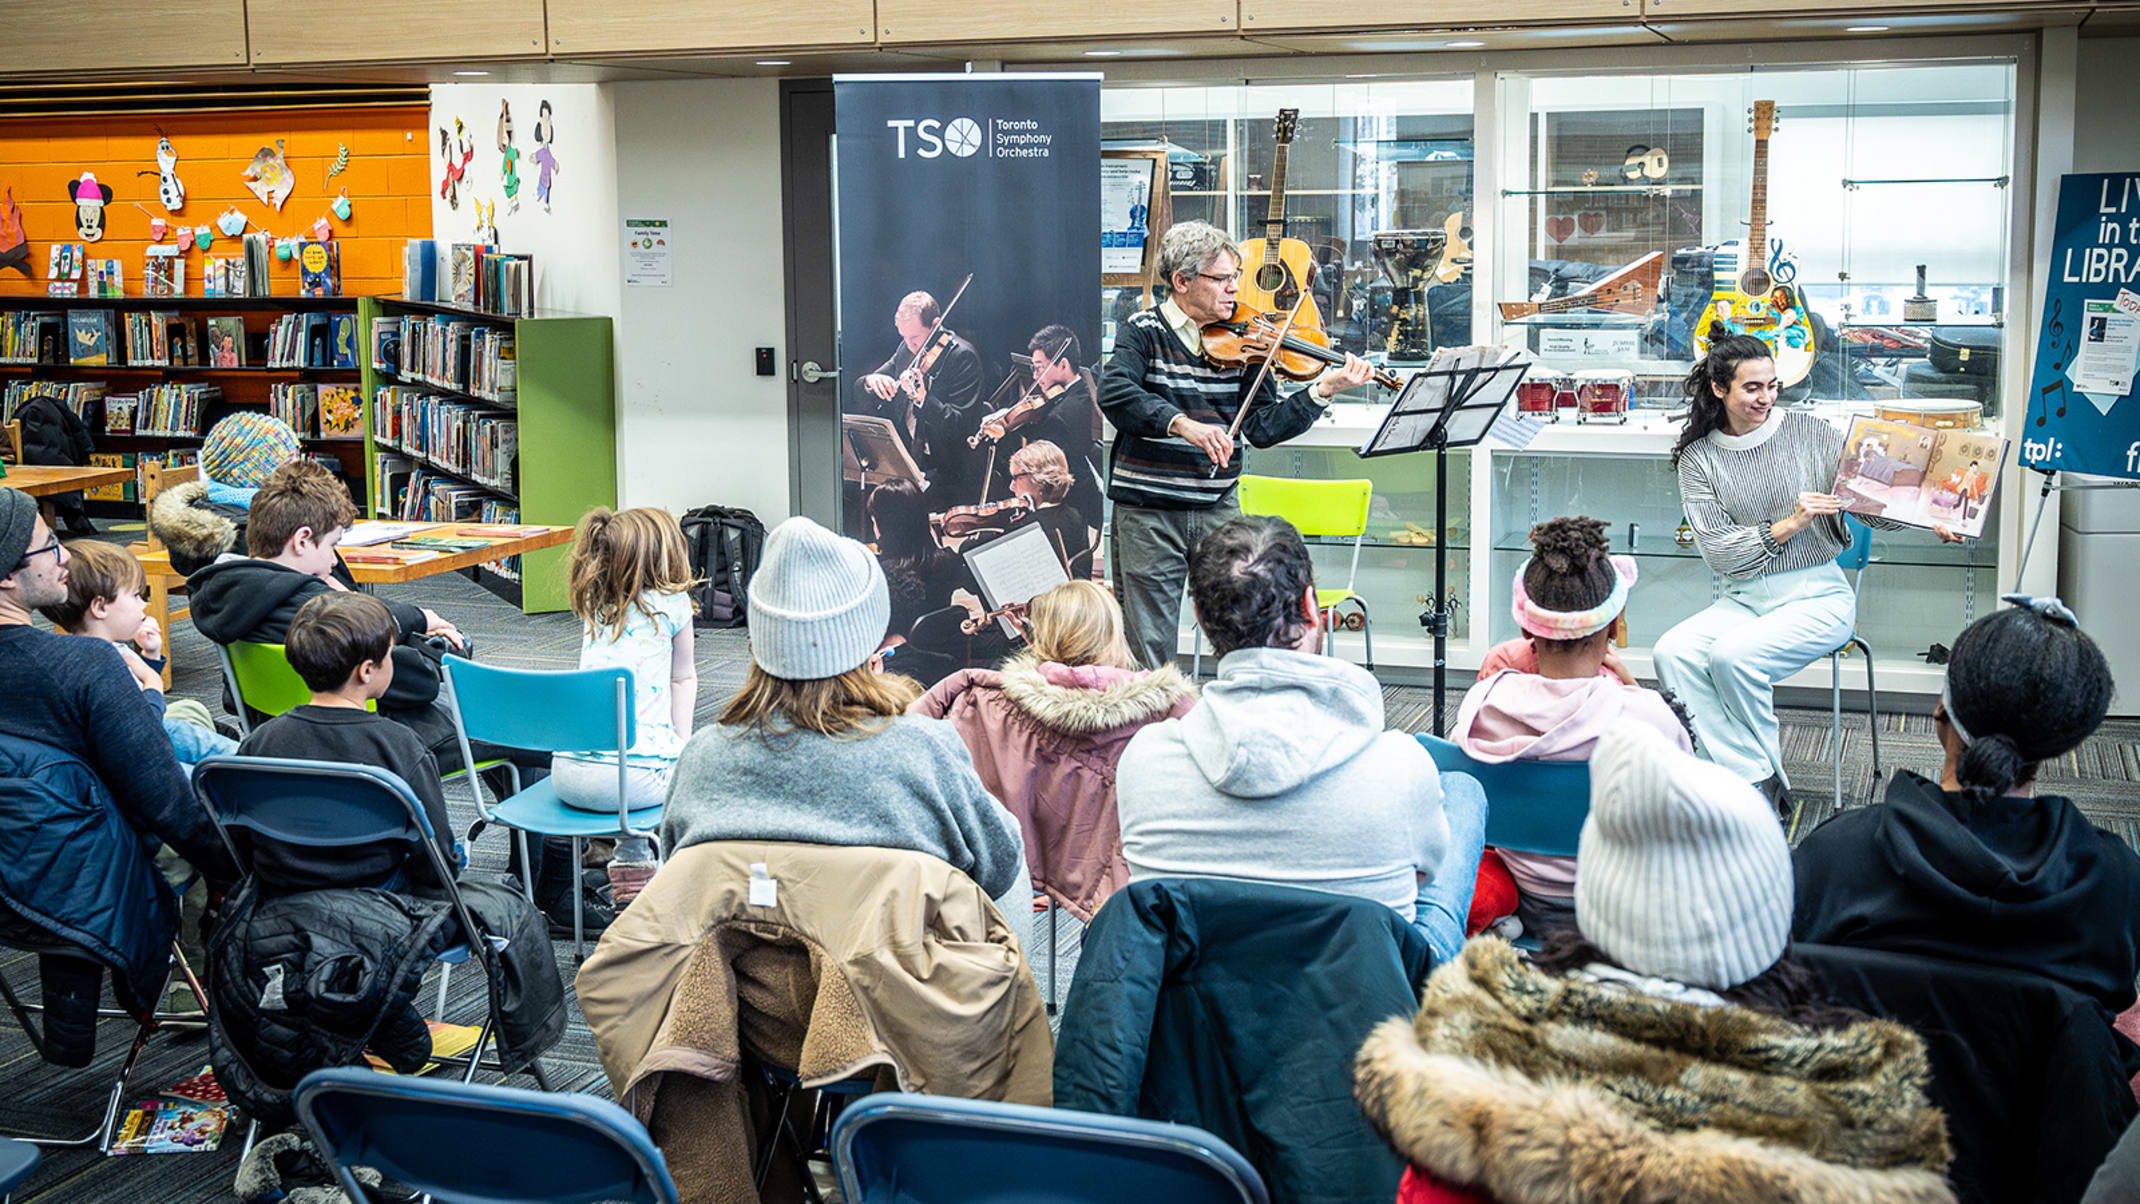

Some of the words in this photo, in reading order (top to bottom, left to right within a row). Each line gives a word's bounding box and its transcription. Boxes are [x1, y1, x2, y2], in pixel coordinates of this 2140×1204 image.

[996, 119, 1039, 131] Toronto
[887, 117, 982, 159] TSO
[996, 133, 1052, 145] Symphony
[996, 146, 1049, 158] Orchestra
[2098, 216, 2120, 244] in
[2128, 217, 2140, 245] t
[2126, 441, 2140, 473] f
